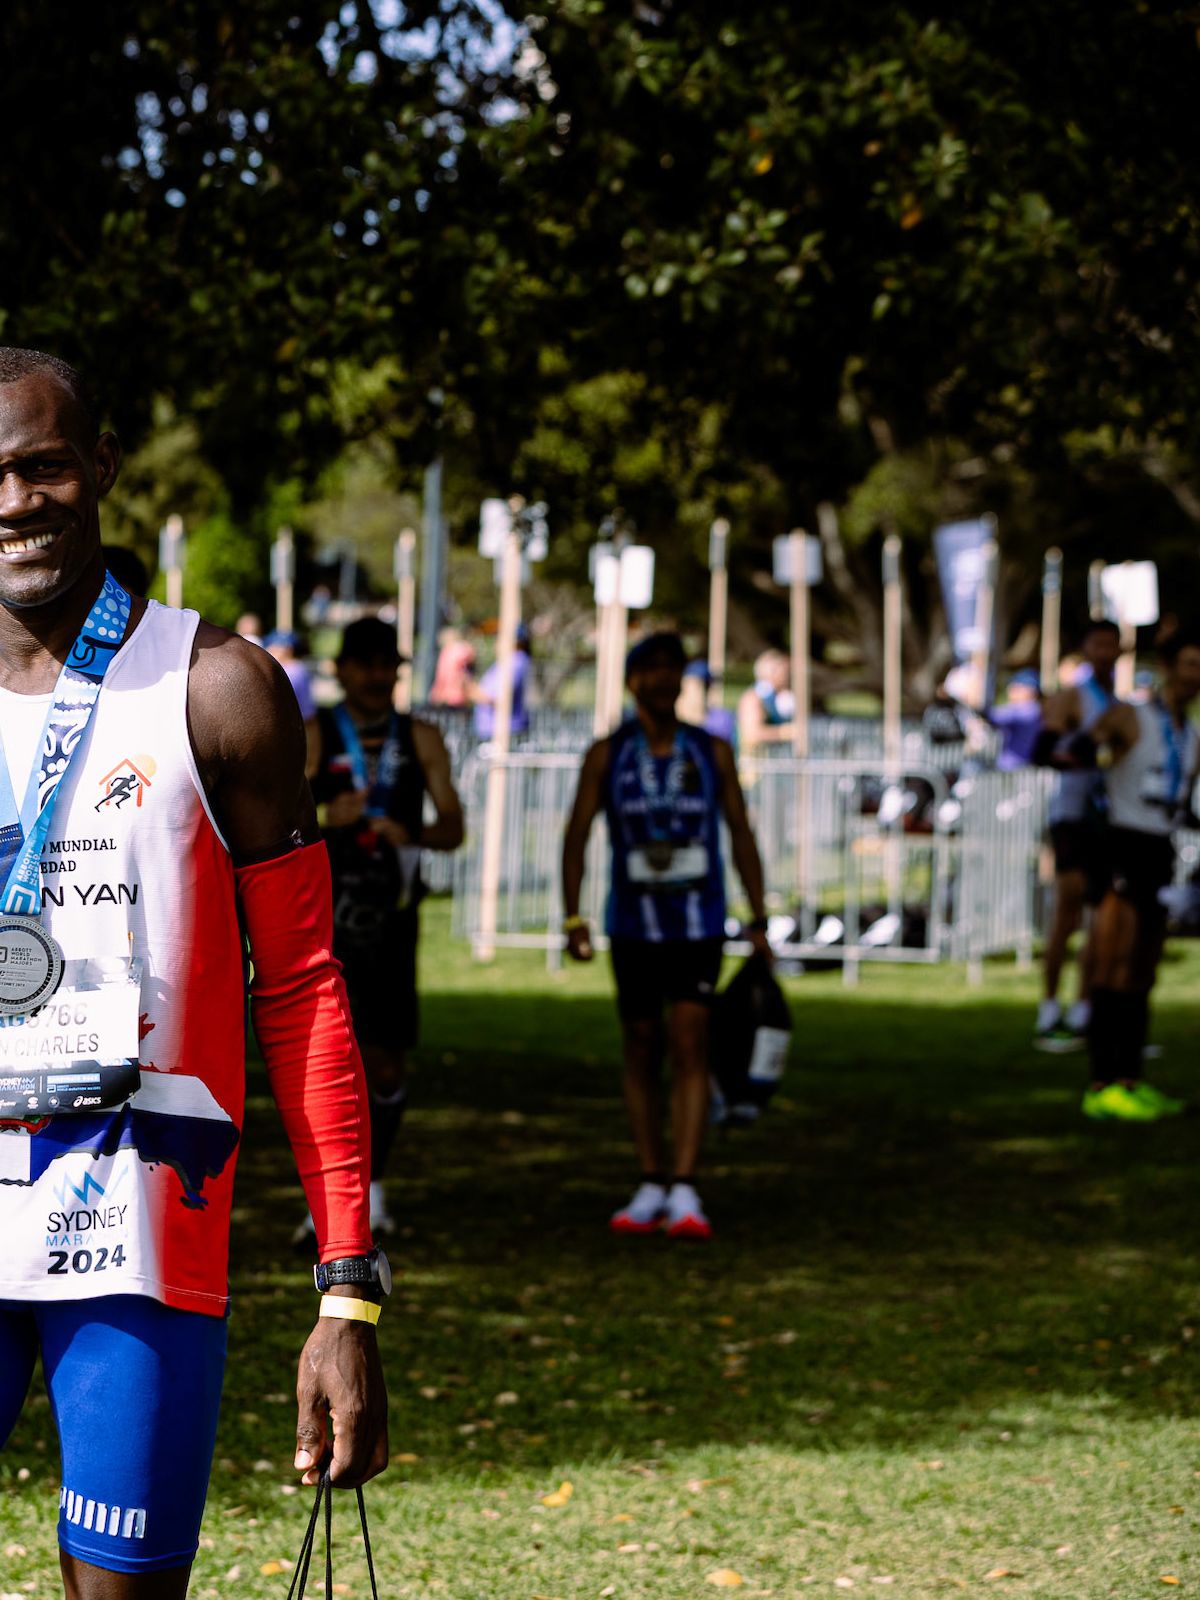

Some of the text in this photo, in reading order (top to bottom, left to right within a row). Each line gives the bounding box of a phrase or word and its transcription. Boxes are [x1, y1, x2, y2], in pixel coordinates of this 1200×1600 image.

[50, 838, 117, 854] MUNDIAL
[15, 849, 34, 882] ABBOTT
[74, 883, 139, 906] YAN
[15, 1032, 100, 1058] CHARLES
[46, 1204, 128, 1233] SYDNEY
[47, 1244, 126, 1275] 2024
